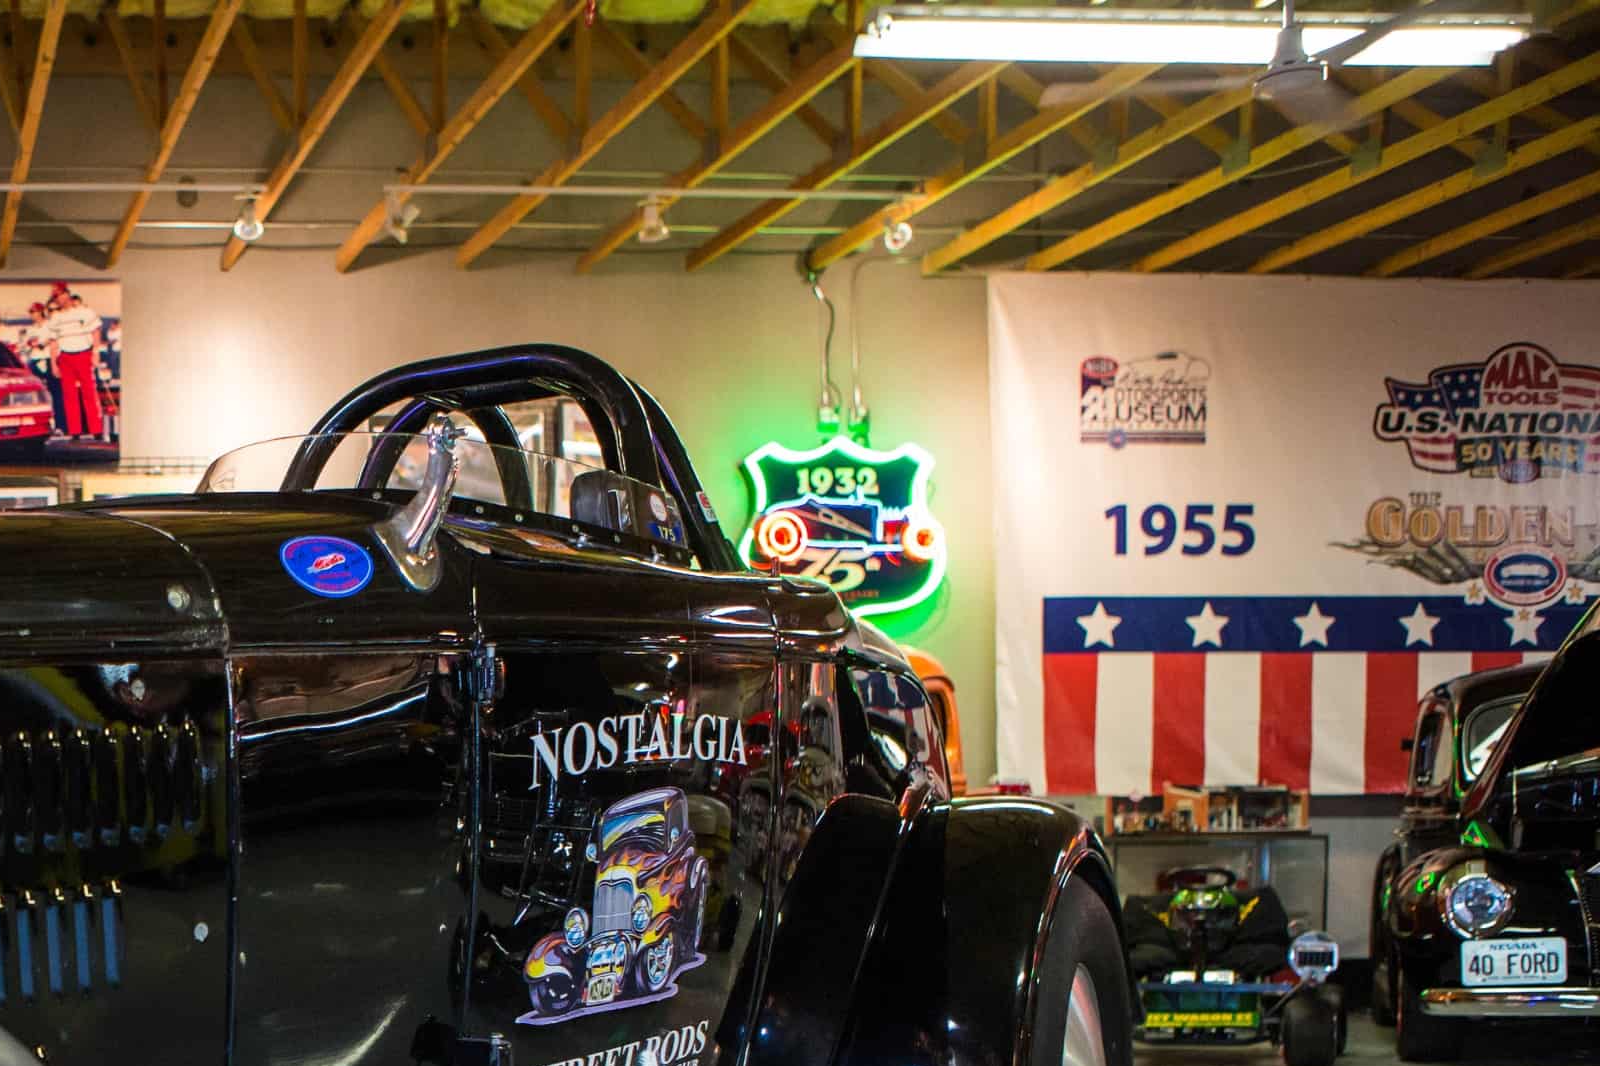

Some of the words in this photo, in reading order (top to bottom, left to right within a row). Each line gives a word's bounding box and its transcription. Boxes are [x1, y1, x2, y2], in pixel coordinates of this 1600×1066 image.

[1483, 350, 1558, 390] MAC
[1483, 391, 1558, 405] TOOLS
[1381, 410, 1448, 434] U.S.
[1461, 442, 1493, 463] 50
[1502, 440, 1578, 463] YEARS
[796, 466, 880, 495] 1932
[1104, 503, 1256, 557] 1955
[1366, 496, 1575, 548] GOLDEN
[528, 713, 748, 791] NOSTALGIA
[1468, 954, 1494, 976] 40
[1506, 951, 1560, 975] FORD
